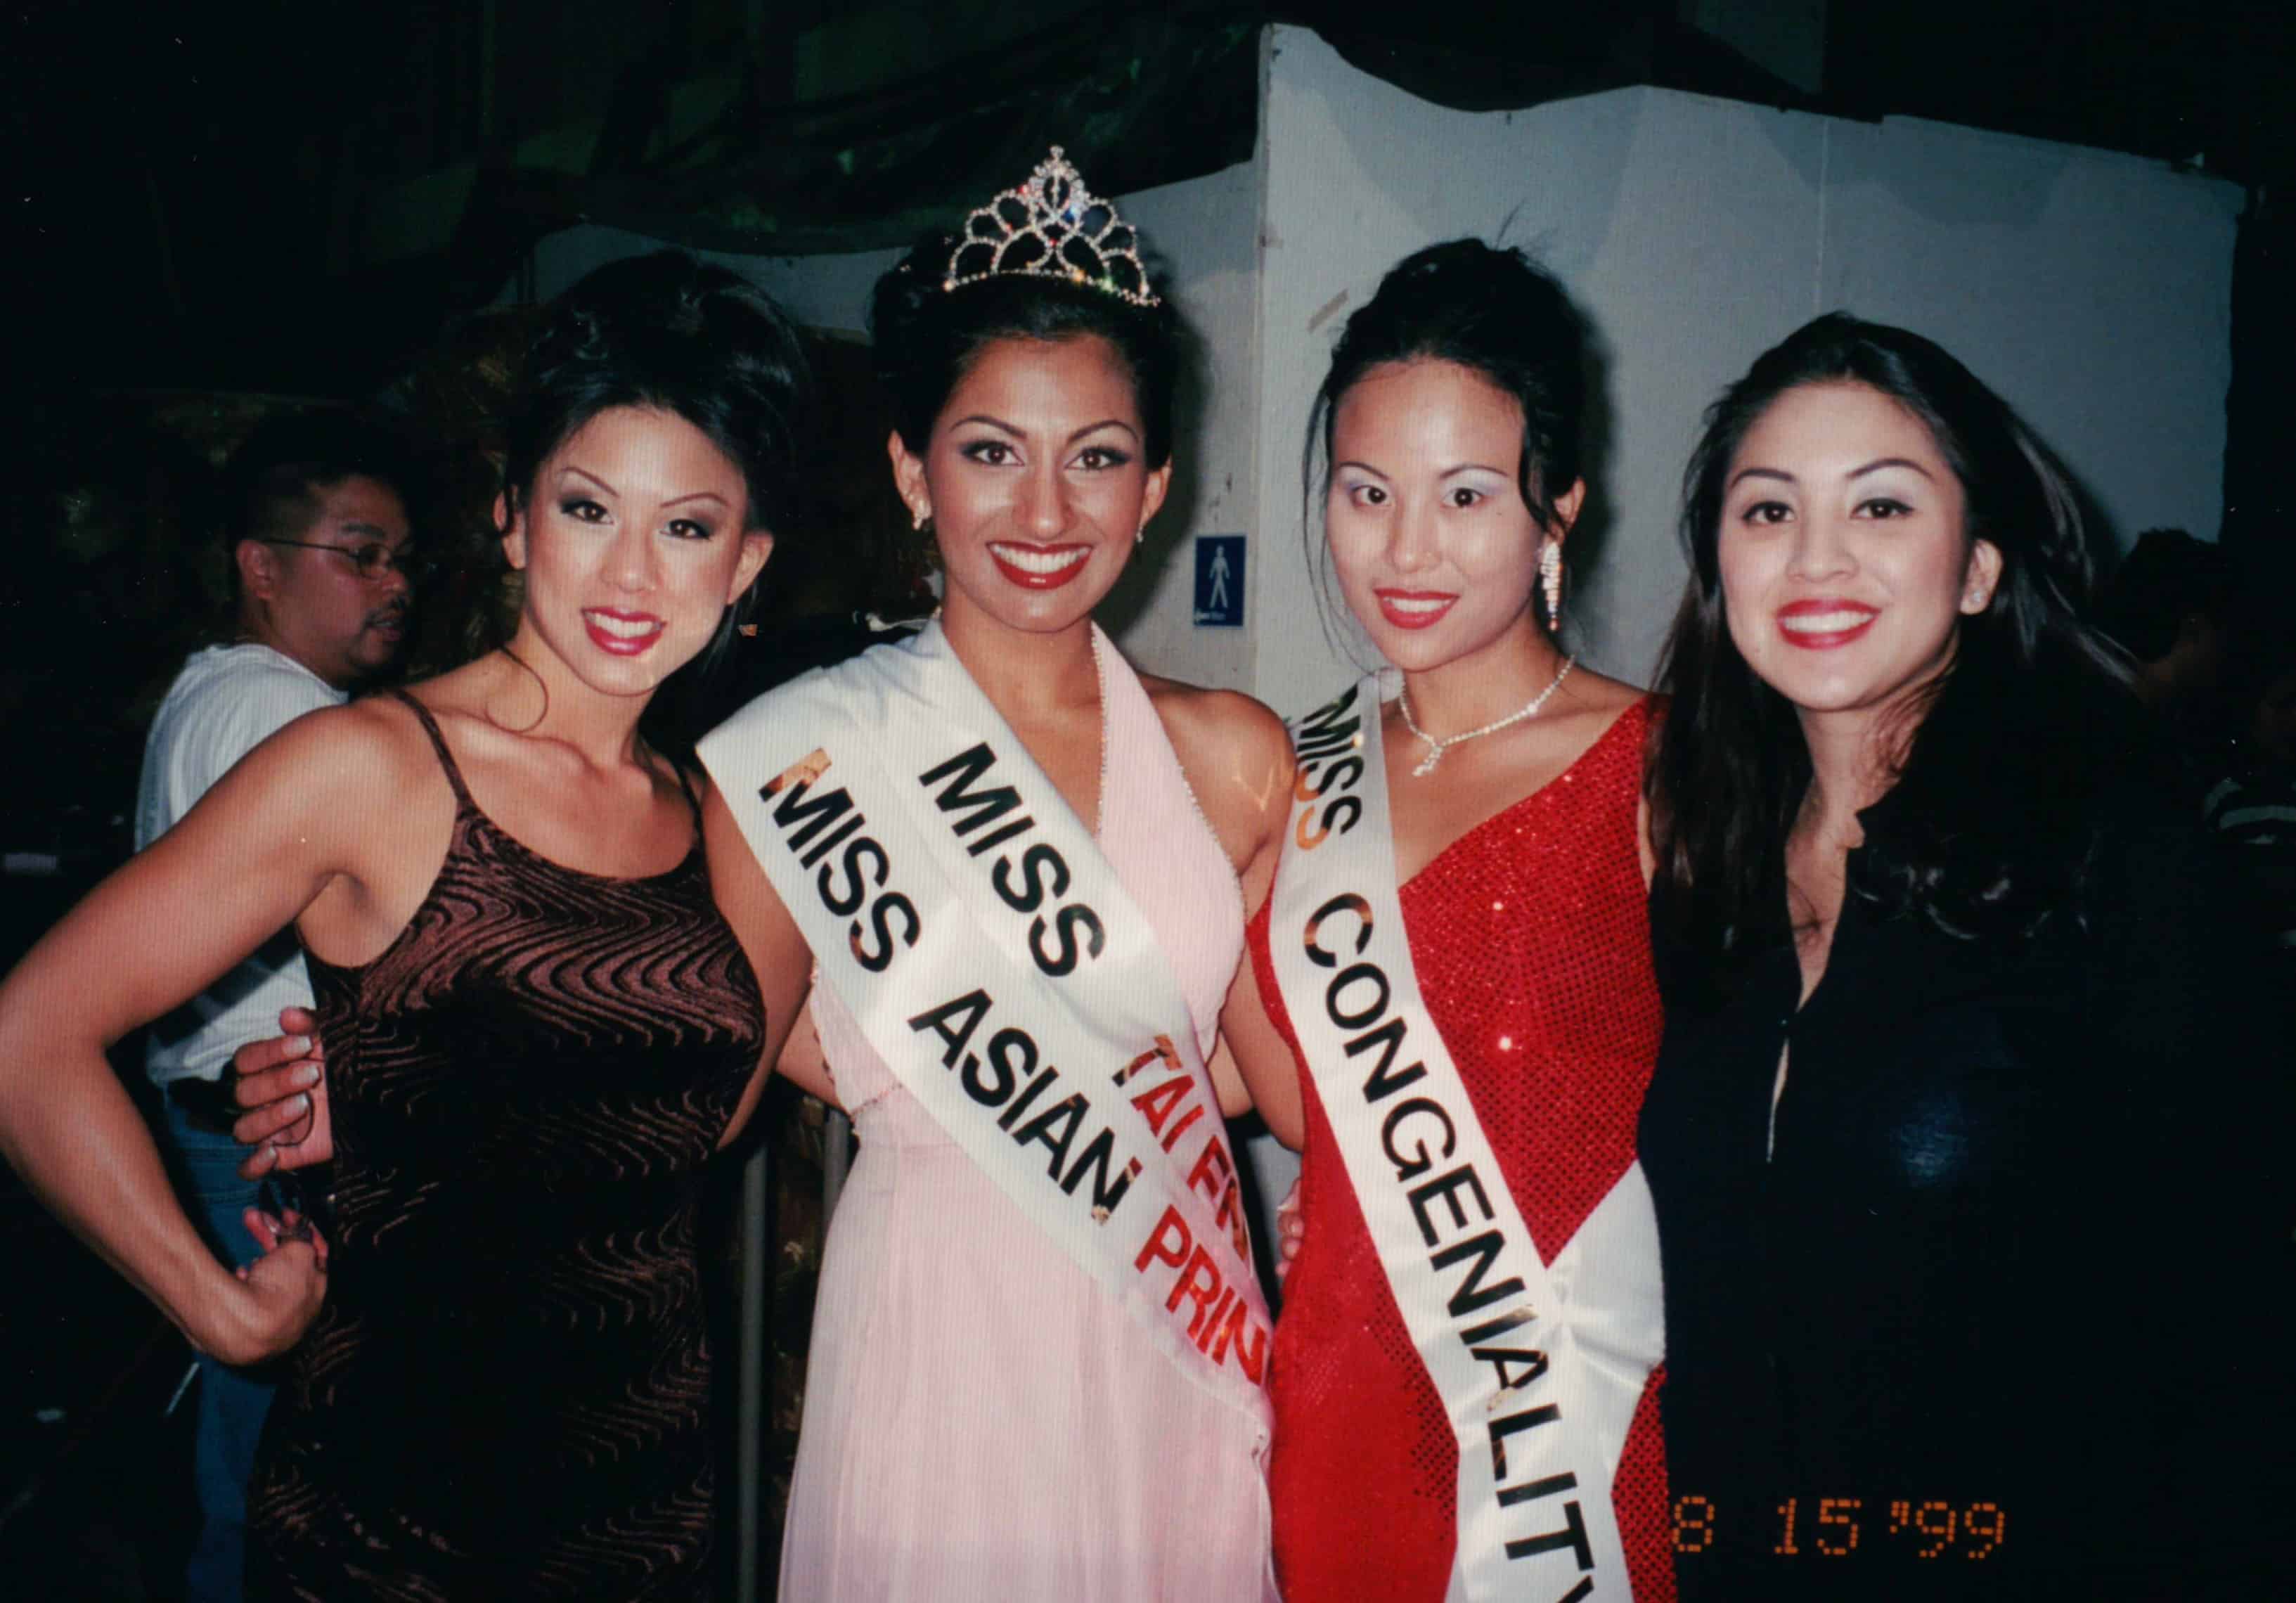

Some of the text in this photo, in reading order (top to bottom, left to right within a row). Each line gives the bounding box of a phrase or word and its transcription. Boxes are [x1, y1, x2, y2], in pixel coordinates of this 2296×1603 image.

[918, 741, 1105, 977] MISS
[1295, 683, 1365, 851] MISS
[759, 747, 1267, 1386] MISS ASIAN PRIN
